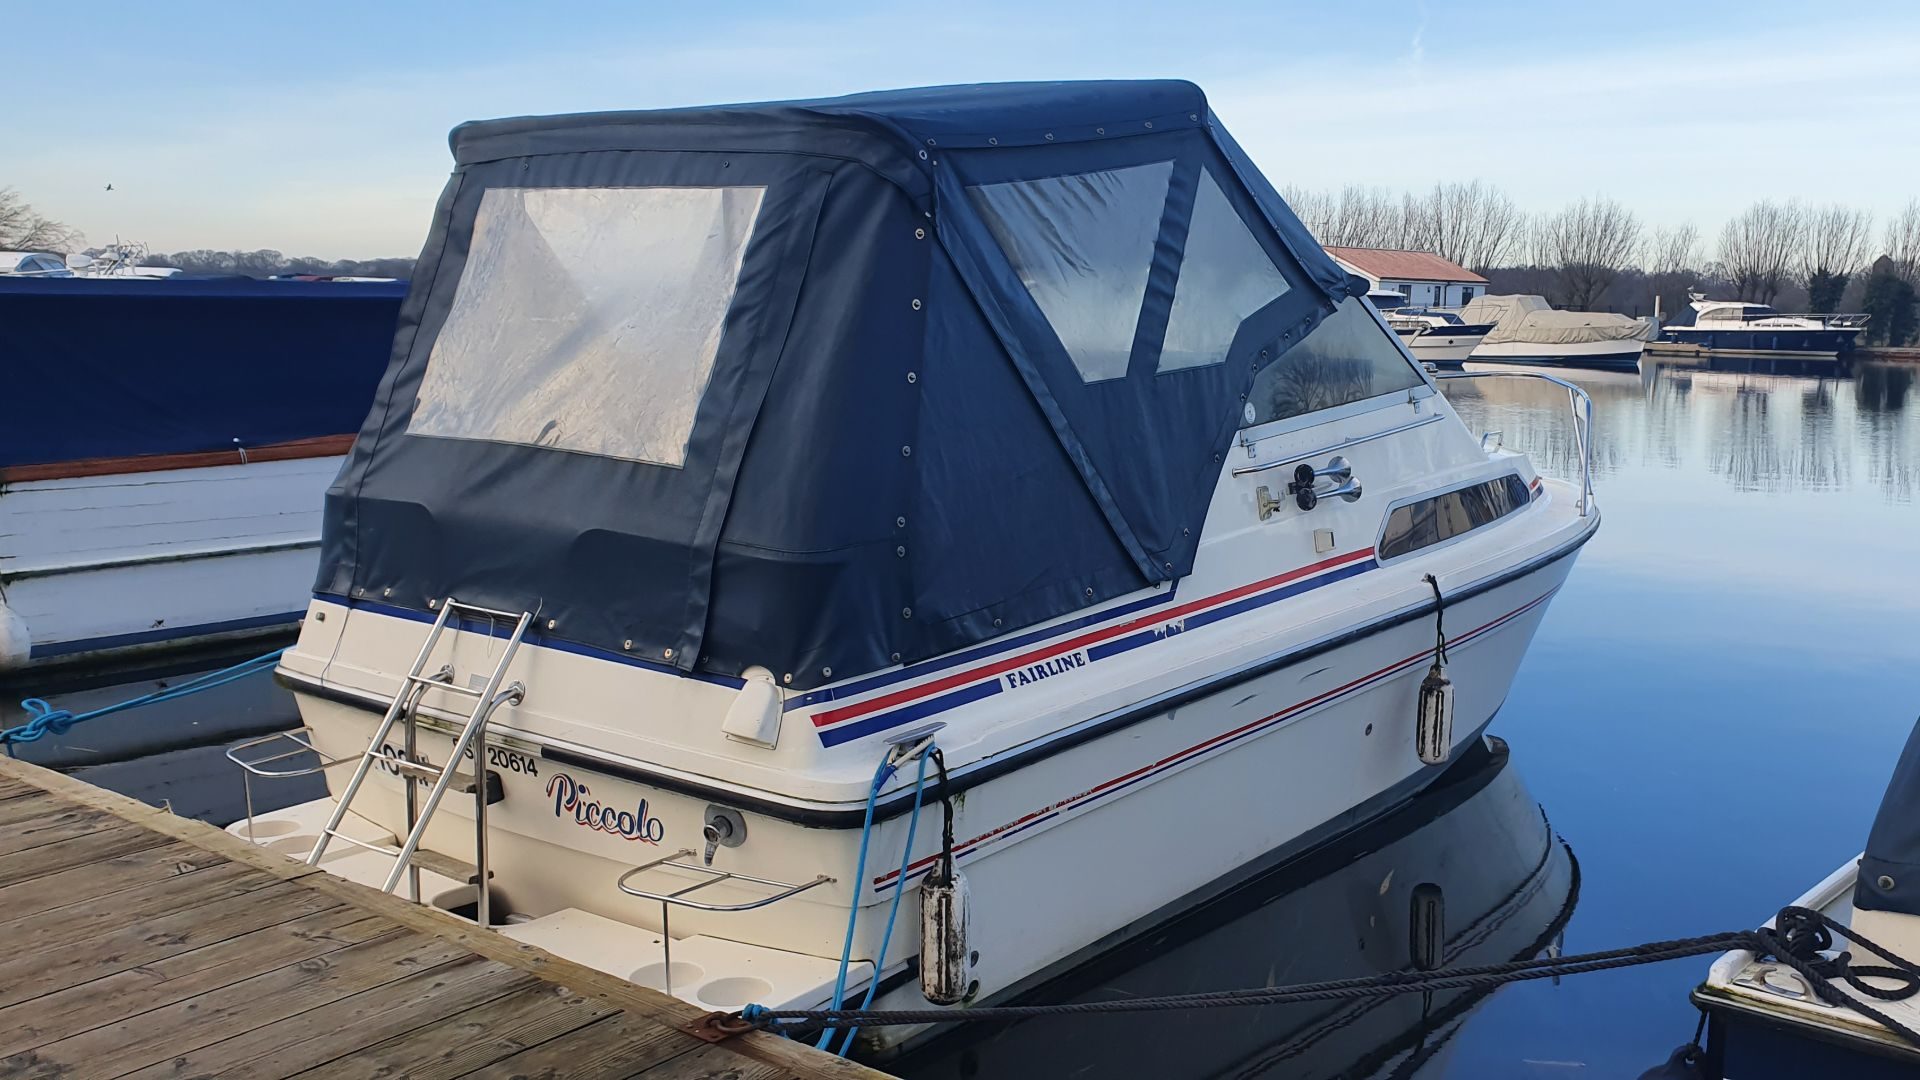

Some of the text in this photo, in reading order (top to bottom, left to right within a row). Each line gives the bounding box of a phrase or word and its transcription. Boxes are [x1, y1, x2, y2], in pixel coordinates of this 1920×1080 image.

[1005, 652, 1086, 689] FAIRLINE
[487, 747, 538, 777] 20614
[546, 773, 664, 846] Piccolo
